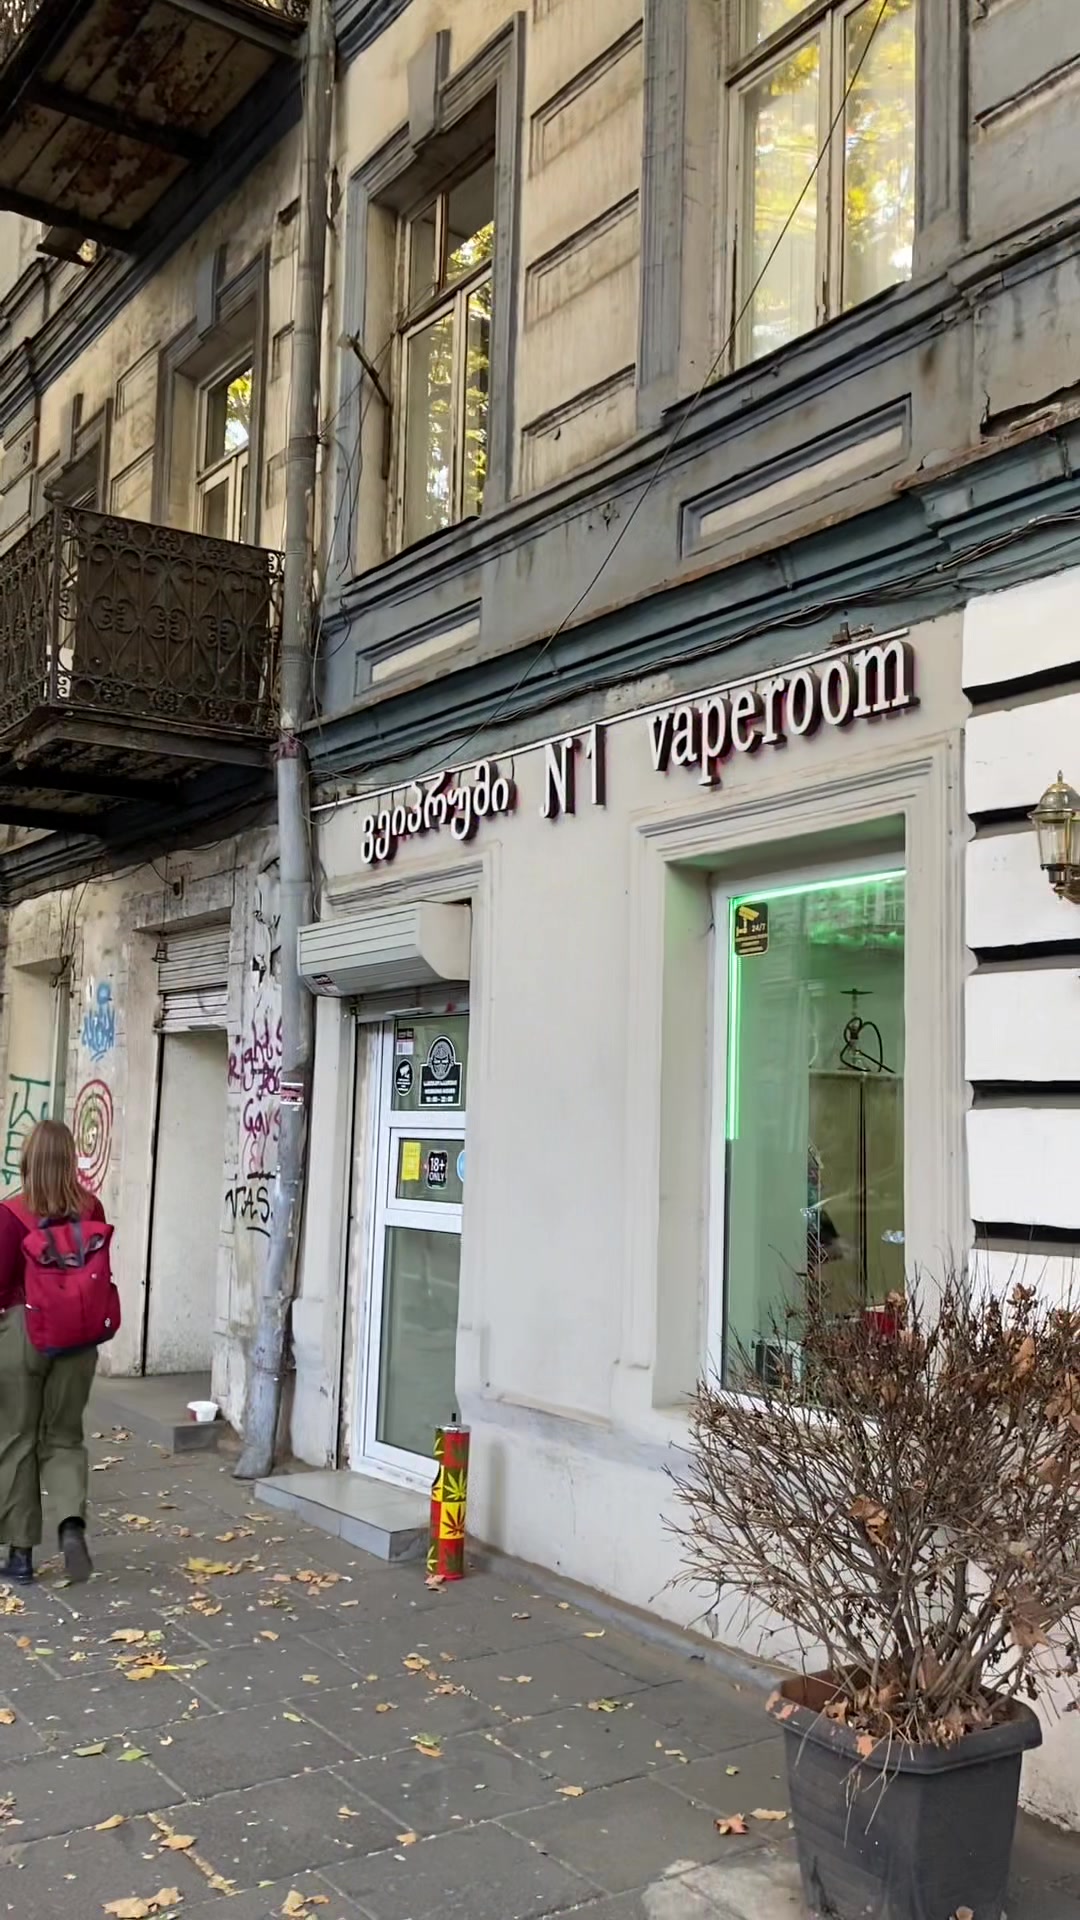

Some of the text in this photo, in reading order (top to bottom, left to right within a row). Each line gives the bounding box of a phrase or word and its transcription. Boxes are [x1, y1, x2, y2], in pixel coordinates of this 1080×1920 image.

[648, 639, 915, 785] vaperoom
[361, 760, 513, 863] ვეიპრუმი
[428, 1172, 445, 1182] ONLY
[430, 1157, 446, 1172] 18+
